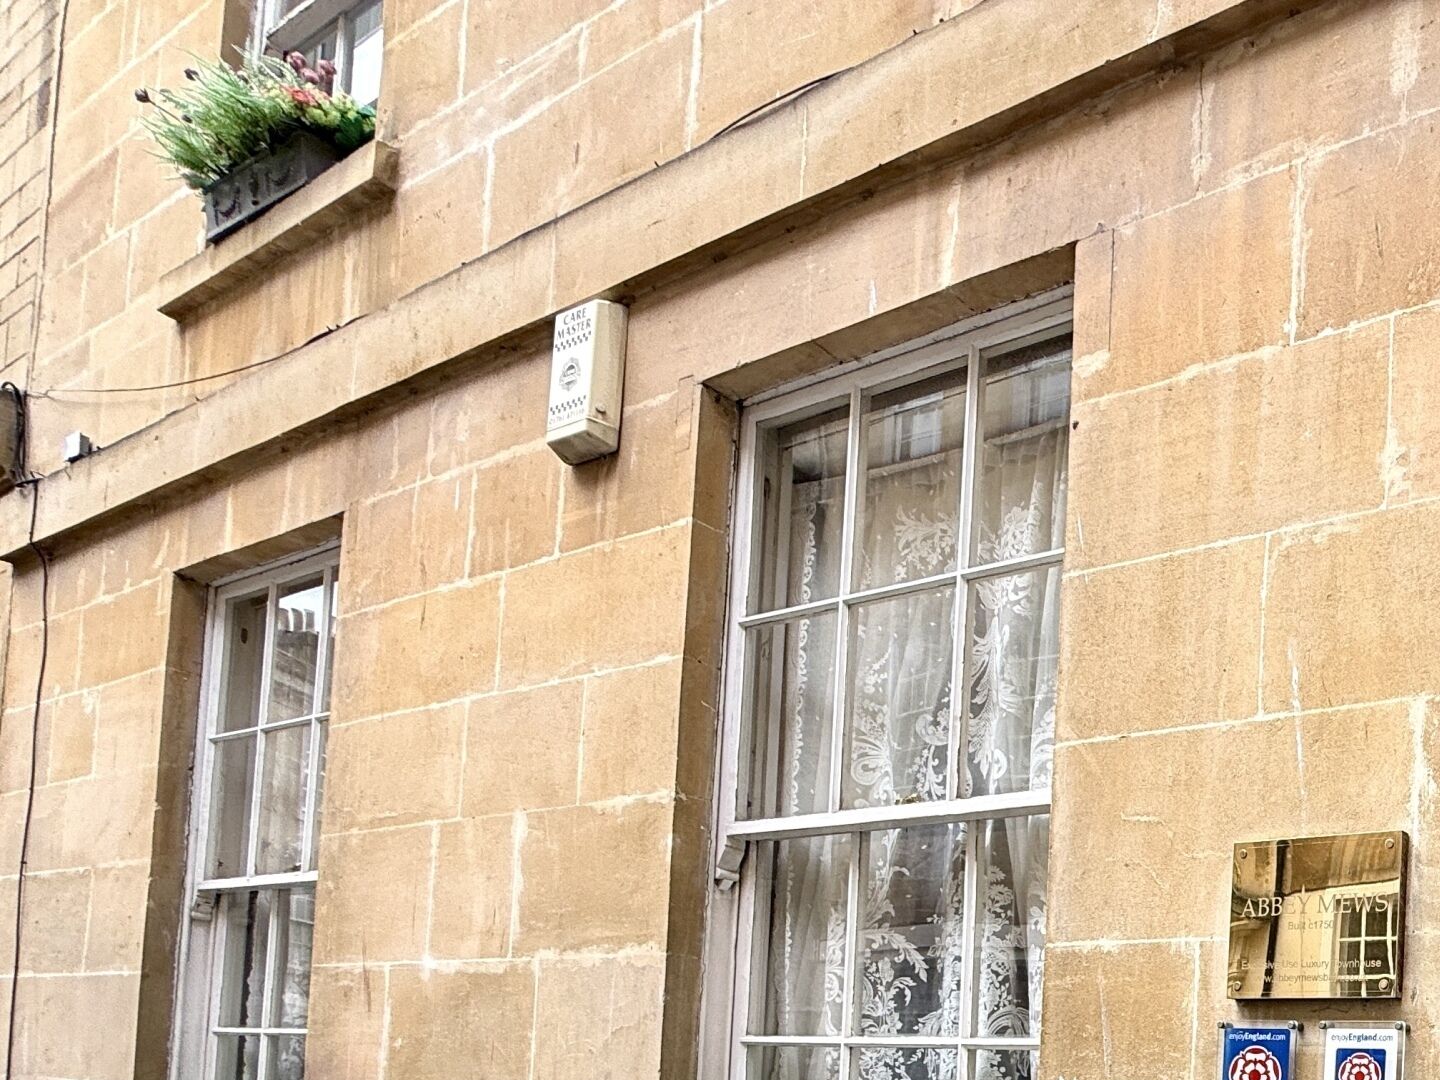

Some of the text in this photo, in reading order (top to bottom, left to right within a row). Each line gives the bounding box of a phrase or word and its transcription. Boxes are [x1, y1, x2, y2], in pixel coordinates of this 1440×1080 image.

[563, 307, 587, 326] CARE
[557, 318, 592, 340] MASTER
[1241, 892, 1390, 918] ABBEY MEWS
[1301, 959, 1330, 971] Luxury
[1335, 958, 1382, 969] ownhuse
[1228, 1031, 1286, 1042] enjoyEngland.com
[1331, 1033, 1394, 1042] enjoyEngland.com
